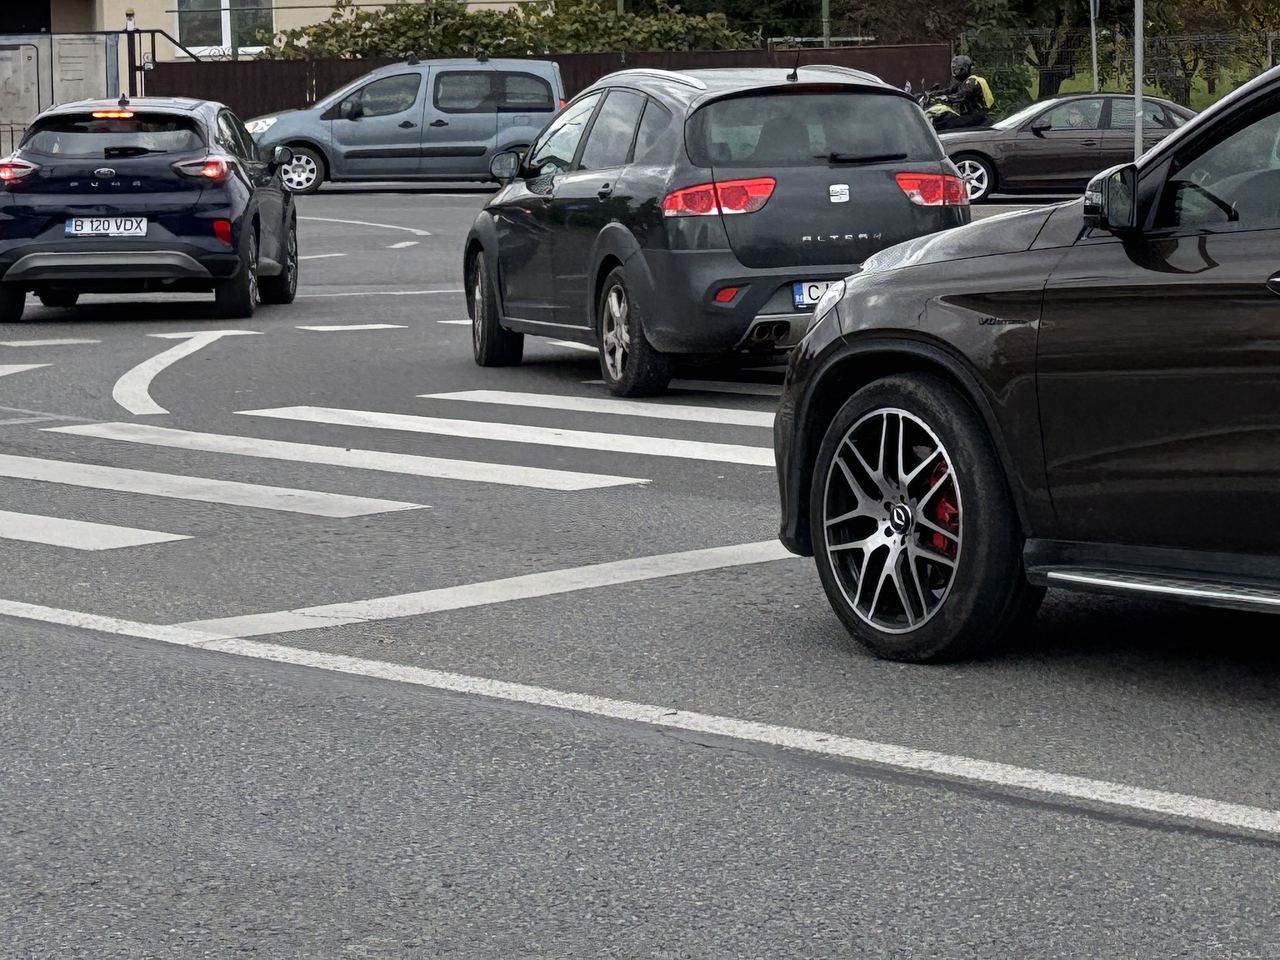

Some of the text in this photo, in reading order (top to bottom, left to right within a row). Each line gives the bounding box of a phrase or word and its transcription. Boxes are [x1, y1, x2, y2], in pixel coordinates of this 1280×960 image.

[74, 218, 143, 232] B 120 VDX
